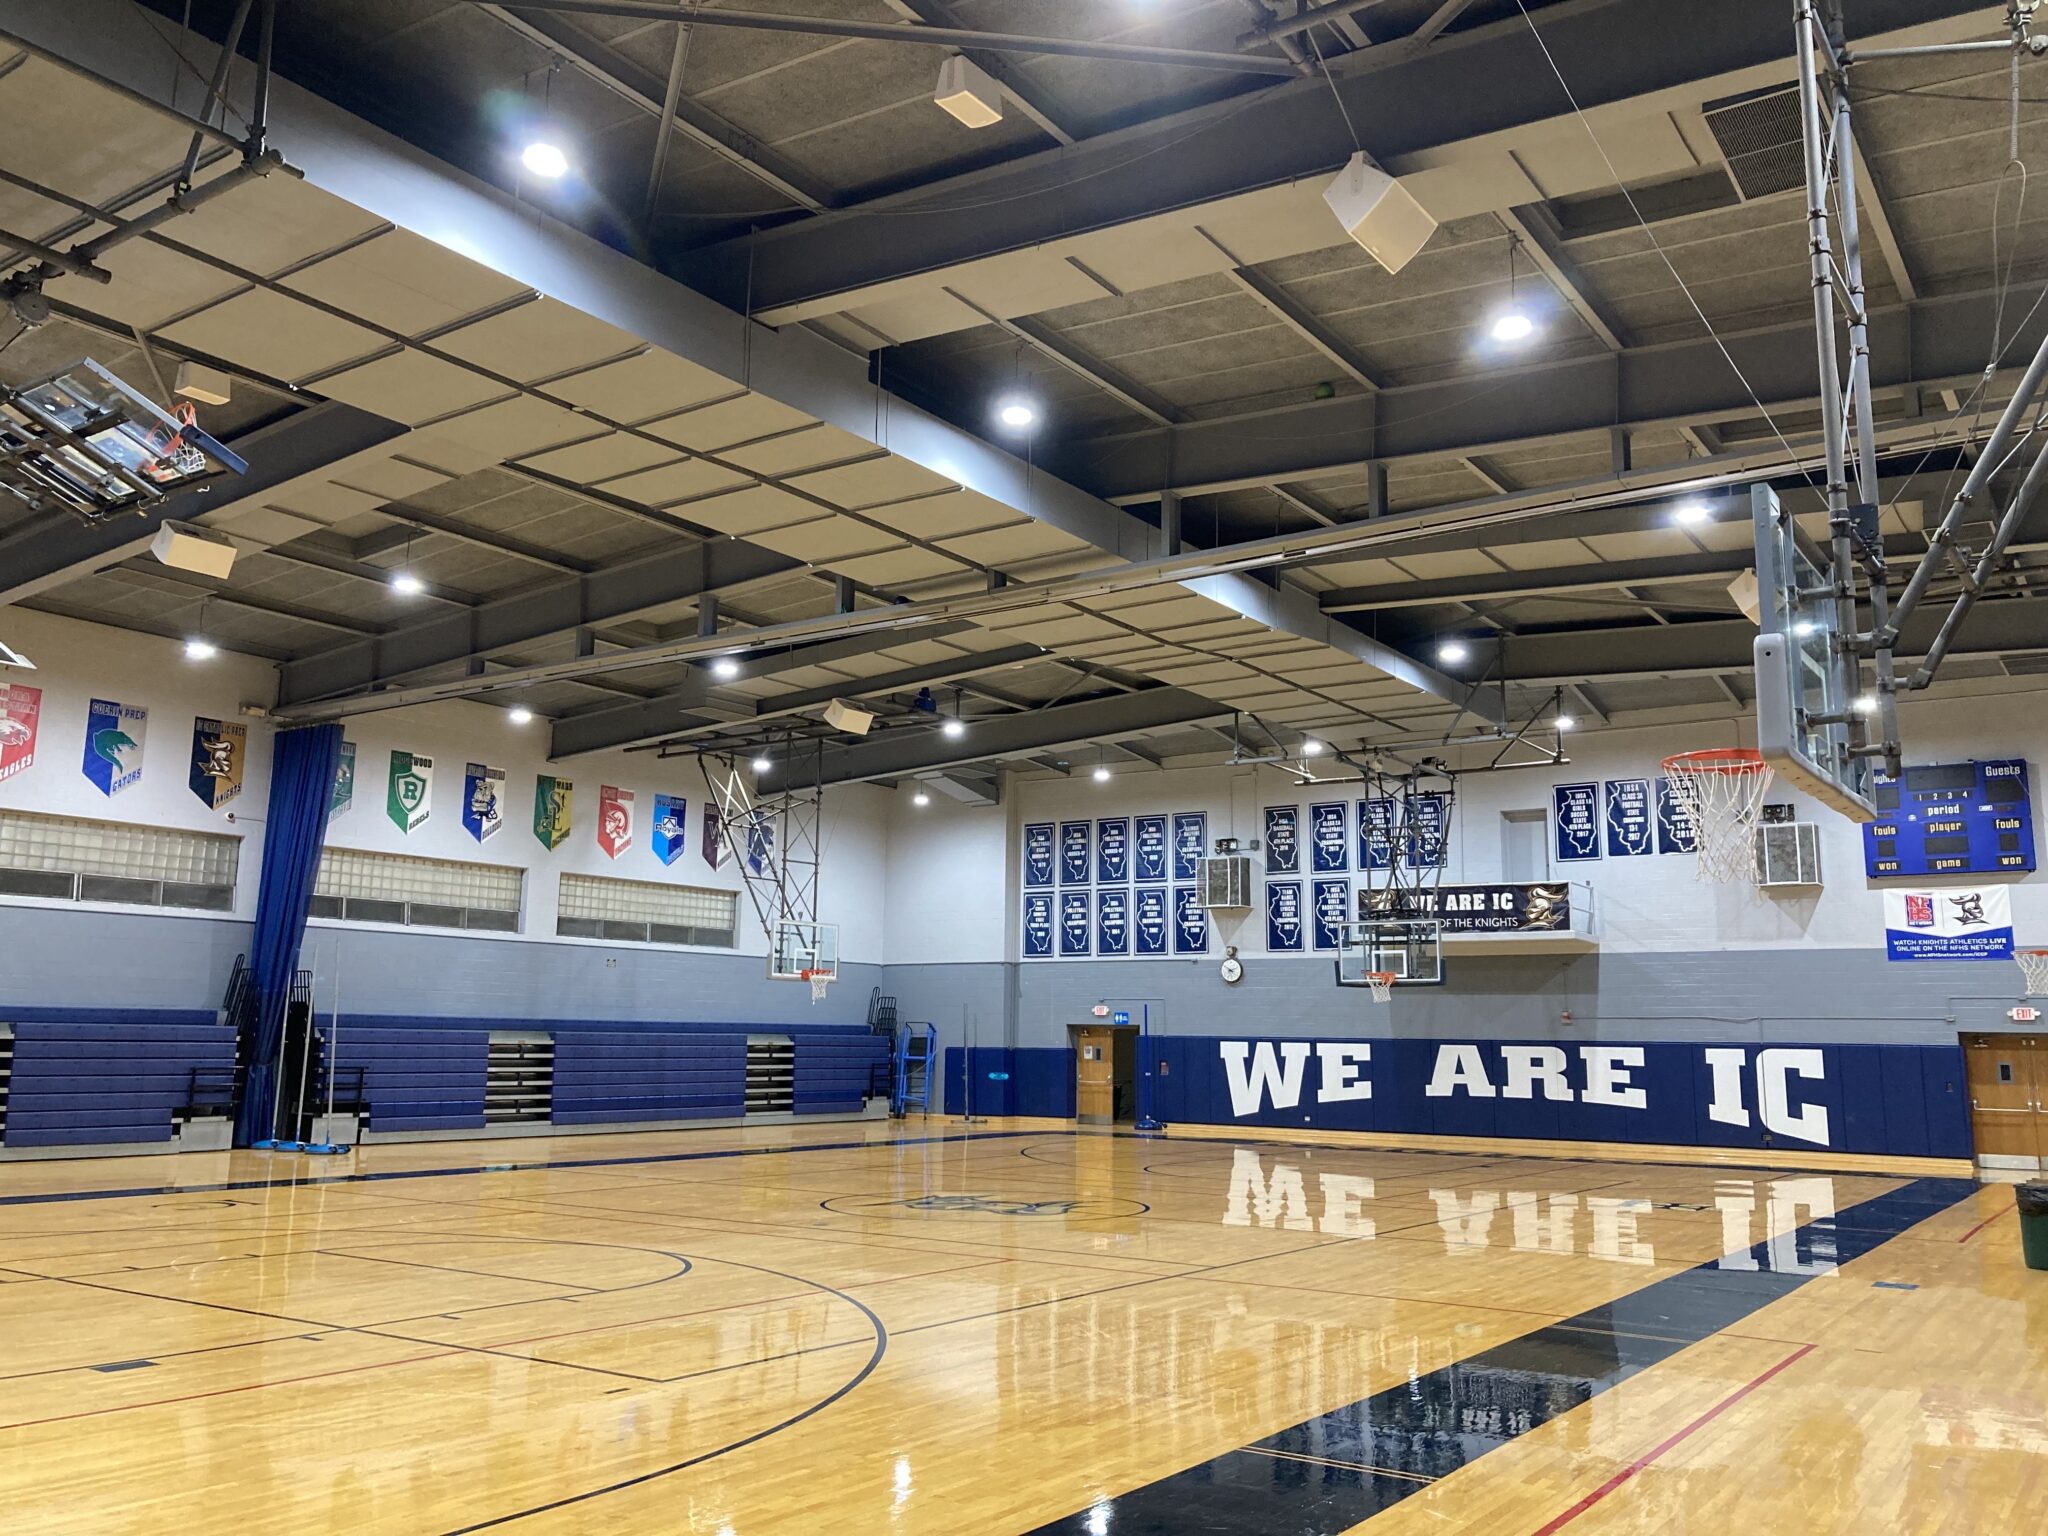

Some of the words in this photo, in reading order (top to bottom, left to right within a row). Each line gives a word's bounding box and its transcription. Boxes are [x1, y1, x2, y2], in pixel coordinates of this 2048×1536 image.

[92, 702, 122, 717] GUERIN
[125, 709, 146, 720] PREP
[1985, 765, 2021, 777] Guests
[112, 768, 142, 792] GATORS
[402, 780, 418, 801] R
[1624, 784, 1639, 792] IHSA
[1635, 792, 1643, 800] 3A
[1947, 792, 1953, 800] 3
[1622, 800, 1644, 808] FOOTBALL
[1927, 804, 1960, 817] period
[655, 823, 684, 835] Royals
[1929, 822, 1962, 834] player
[1995, 819, 2020, 829] fouls
[1873, 826, 1896, 836] fouls
[1878, 862, 1898, 870] won
[1936, 859, 1961, 870] game
[2001, 856, 2022, 865] won
[1445, 893, 1485, 911] ARE
[1492, 892, 1514, 910] IC
[1440, 918, 1452, 928] OF
[1452, 918, 1473, 928] THE
[1474, 917, 1519, 928] KNIGHTS
[2016, 1008, 2032, 1019] EXIT
[1220, 1041, 1373, 1117] WE
[1425, 1044, 1648, 1109] ARE
[1704, 1047, 1830, 1147] IC
